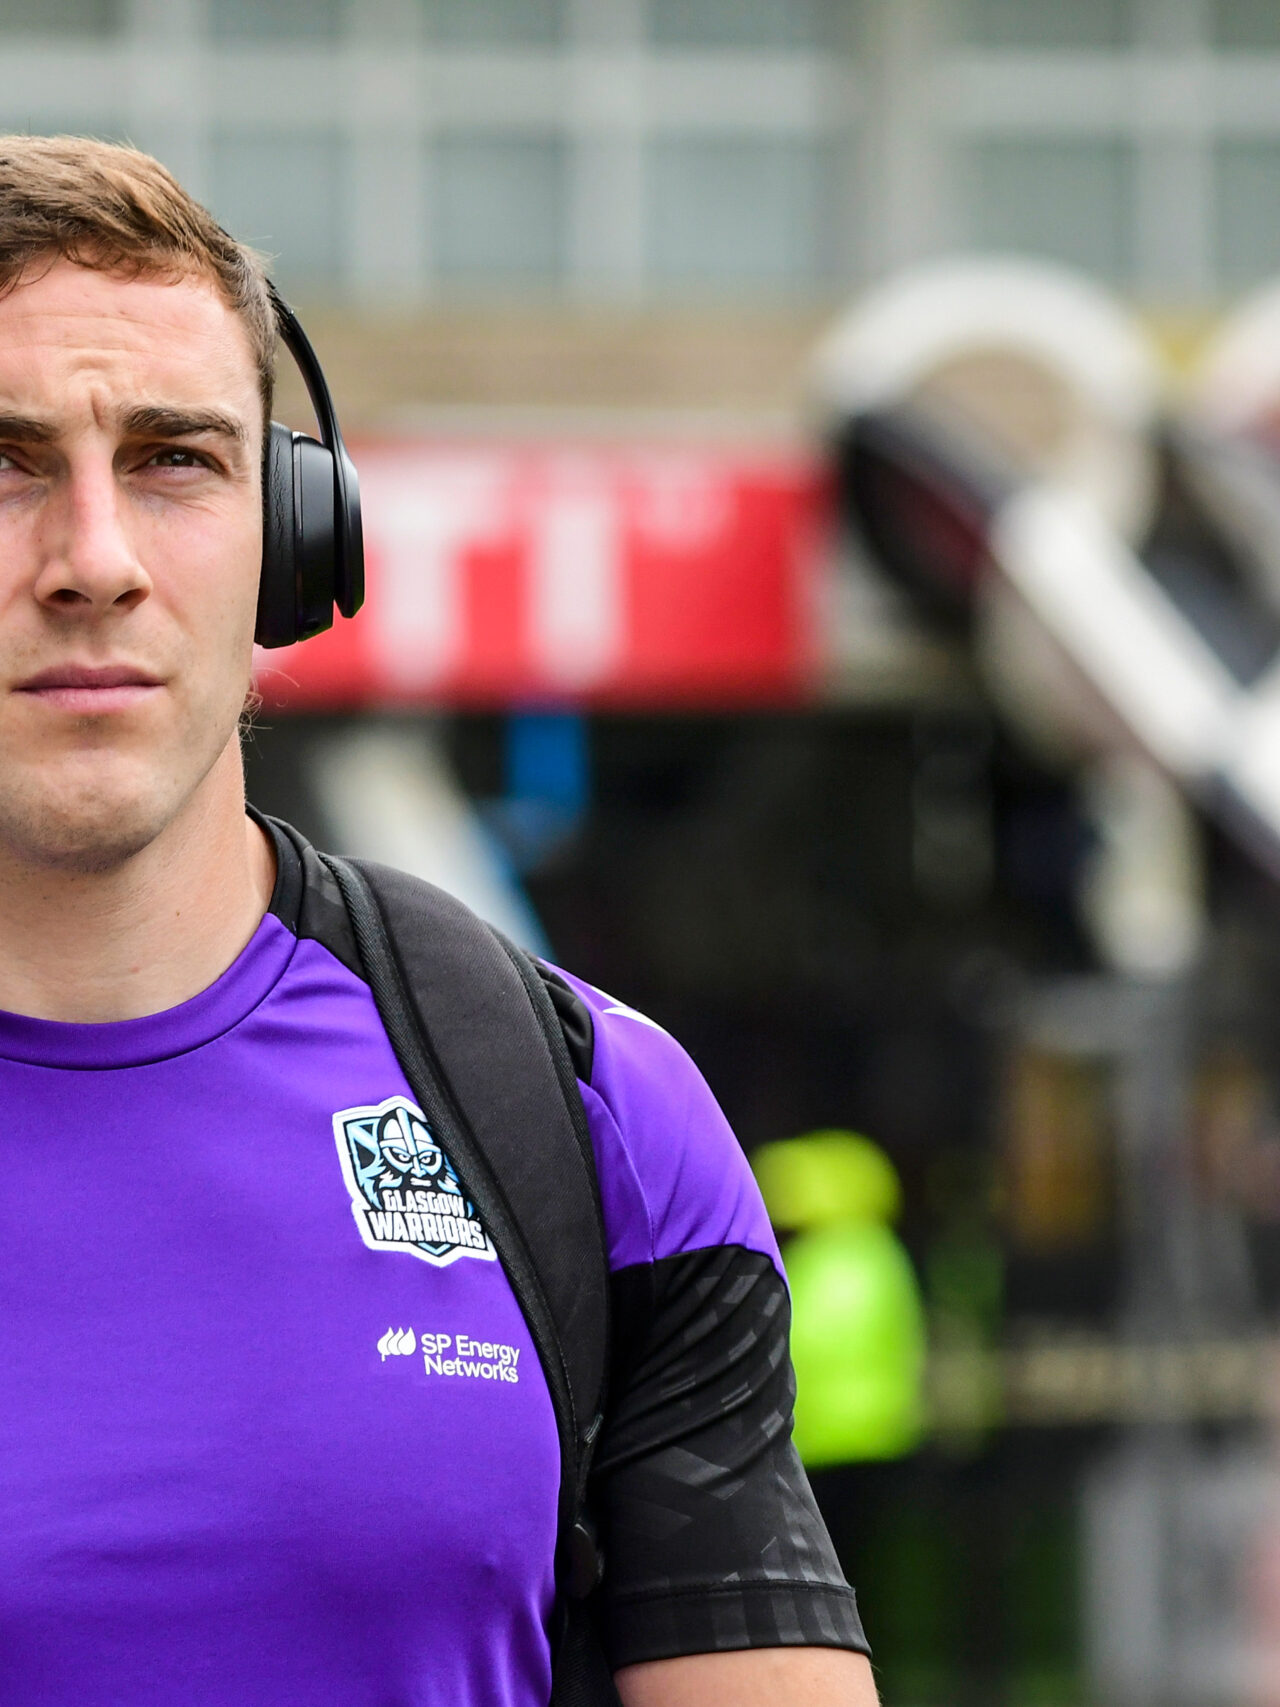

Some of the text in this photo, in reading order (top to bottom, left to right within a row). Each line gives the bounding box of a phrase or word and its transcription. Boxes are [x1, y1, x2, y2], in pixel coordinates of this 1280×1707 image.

[381, 1189, 465, 1218] GLASGOW
[368, 1211, 487, 1250] WARRIORS
[420, 1333, 520, 1367] SP Energy
[423, 1354, 519, 1383] Networks
